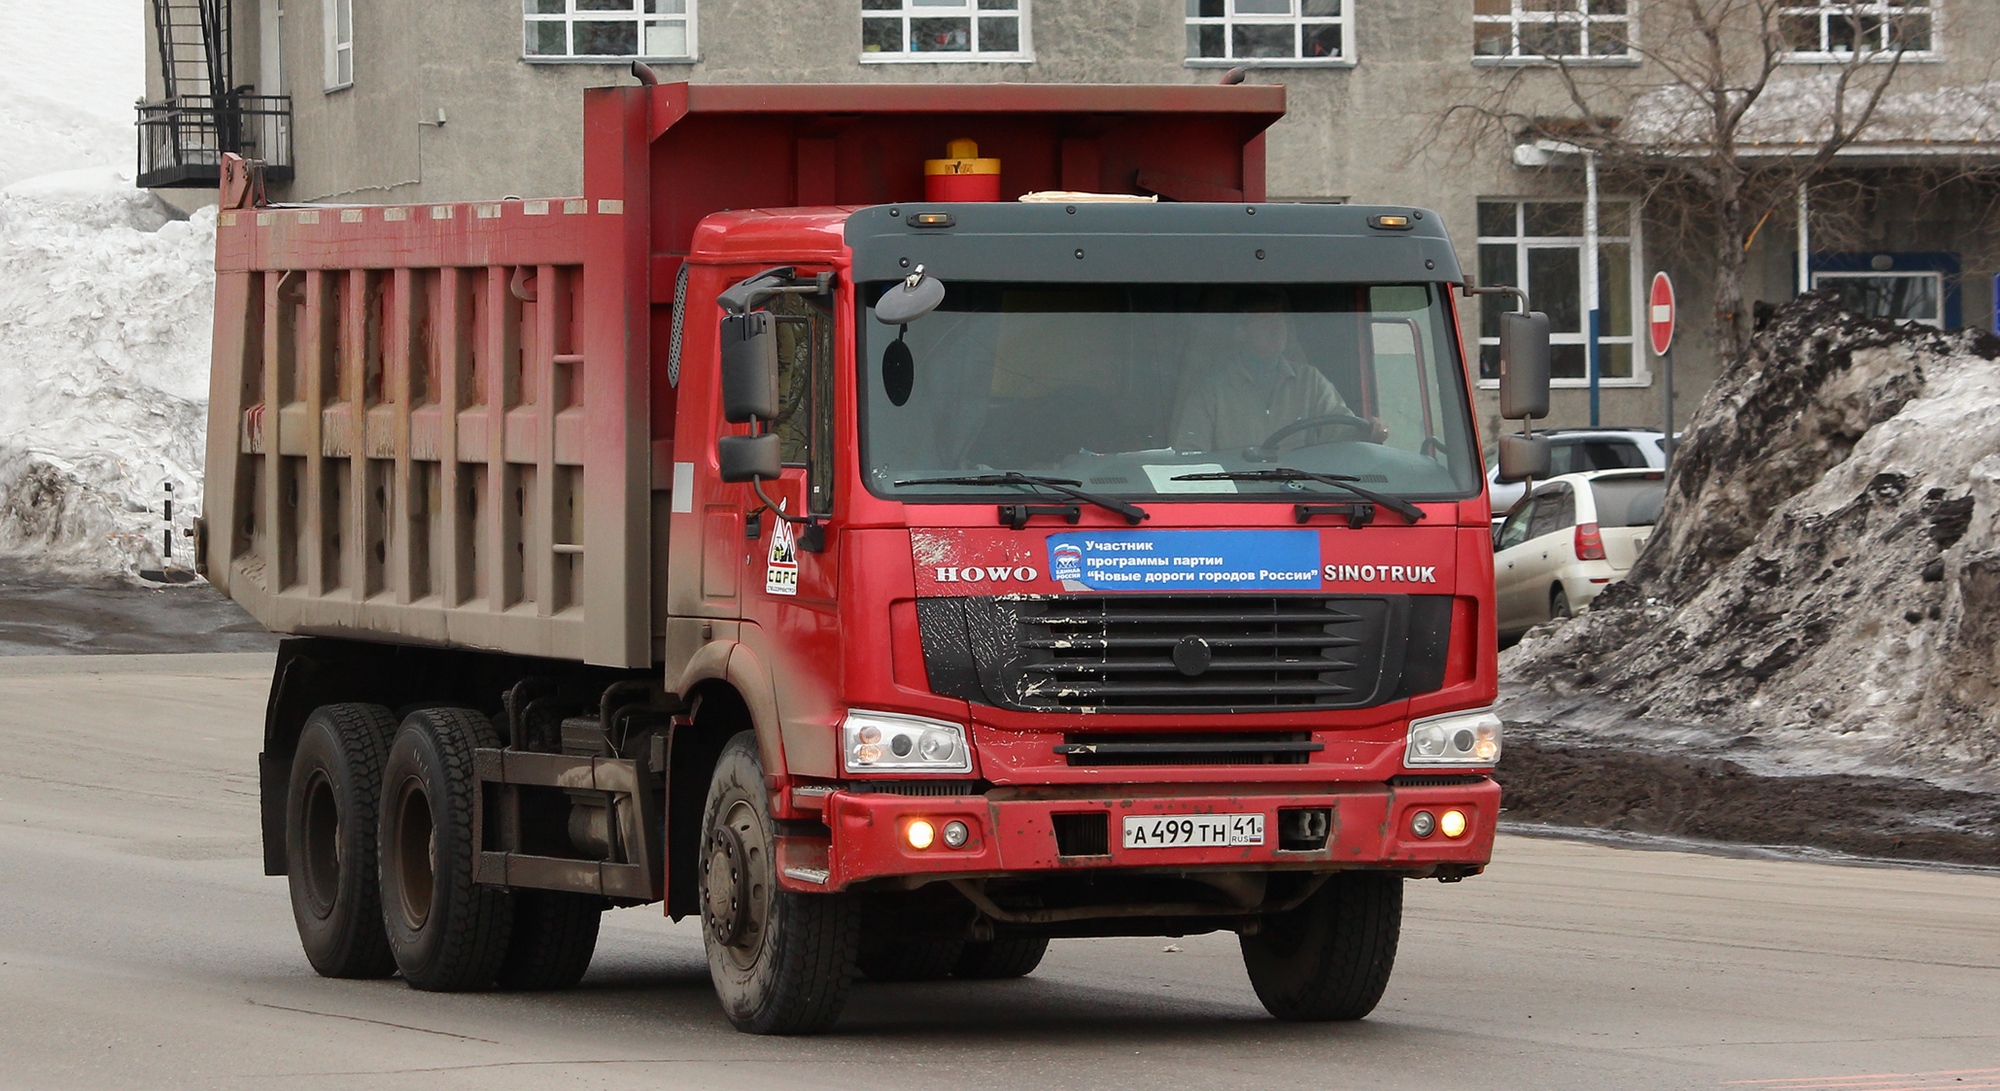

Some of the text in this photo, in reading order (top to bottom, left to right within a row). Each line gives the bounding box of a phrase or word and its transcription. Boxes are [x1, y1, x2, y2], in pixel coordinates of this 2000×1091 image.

[1085, 540, 1154, 551] Участник
[1086, 557, 1224, 568] программы партии
[935, 566, 1038, 582] HOWO
[1145, 571, 1195, 583] дороги
[1199, 571, 1256, 583] городов
[1324, 564, 1436, 583] SINOTRUK
[1231, 835, 1249, 843] RUS
